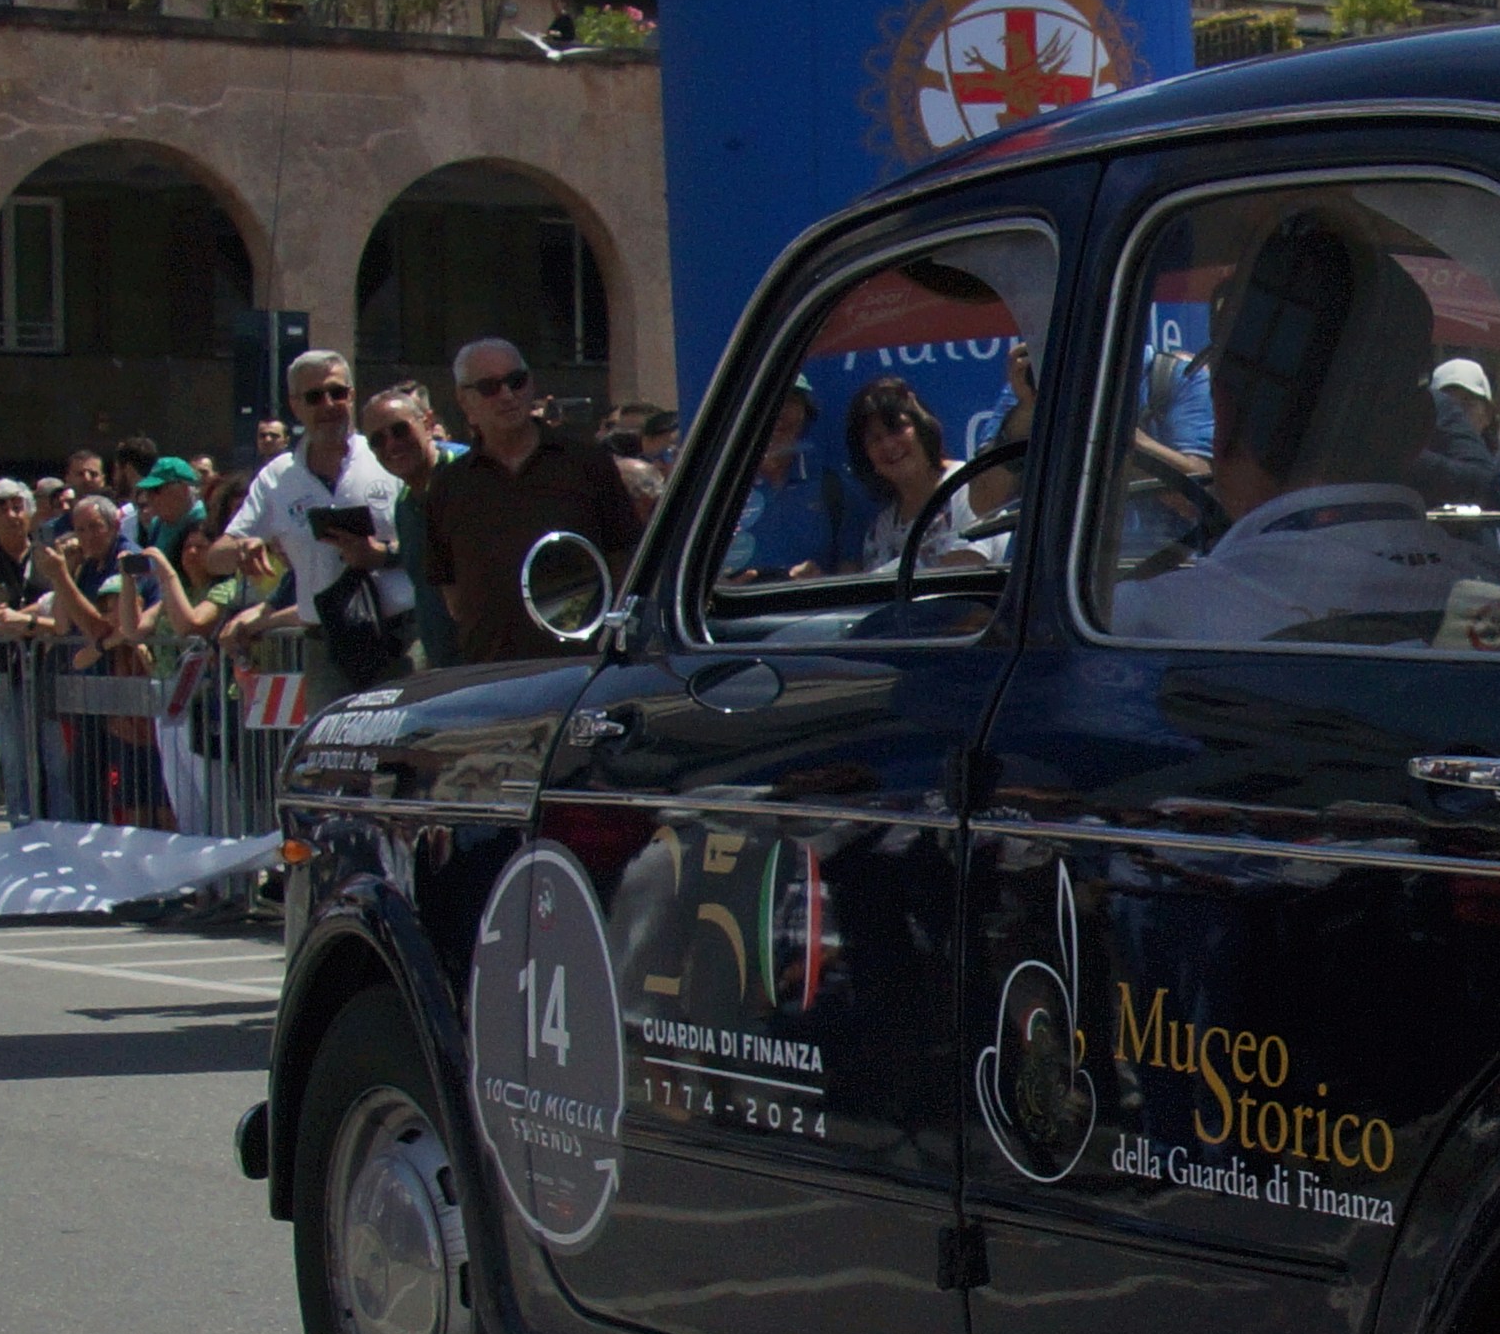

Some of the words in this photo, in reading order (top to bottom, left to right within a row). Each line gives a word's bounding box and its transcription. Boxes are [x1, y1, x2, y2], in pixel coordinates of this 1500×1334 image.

[518, 958, 570, 1067] 14
[642, 1017, 716, 1054] GUARDIA
[720, 1029, 737, 1058] DI
[743, 1033, 823, 1074] FINANZA
[508, 1116, 583, 1158] FRIENDS
[544, 1094, 604, 1134] MIGLIA
[1112, 1133, 1161, 1179] della
[1168, 1147, 1259, 1200] Guardia
[1265, 1170, 1290, 1207] di
[1298, 1170, 1396, 1227] Finanza
